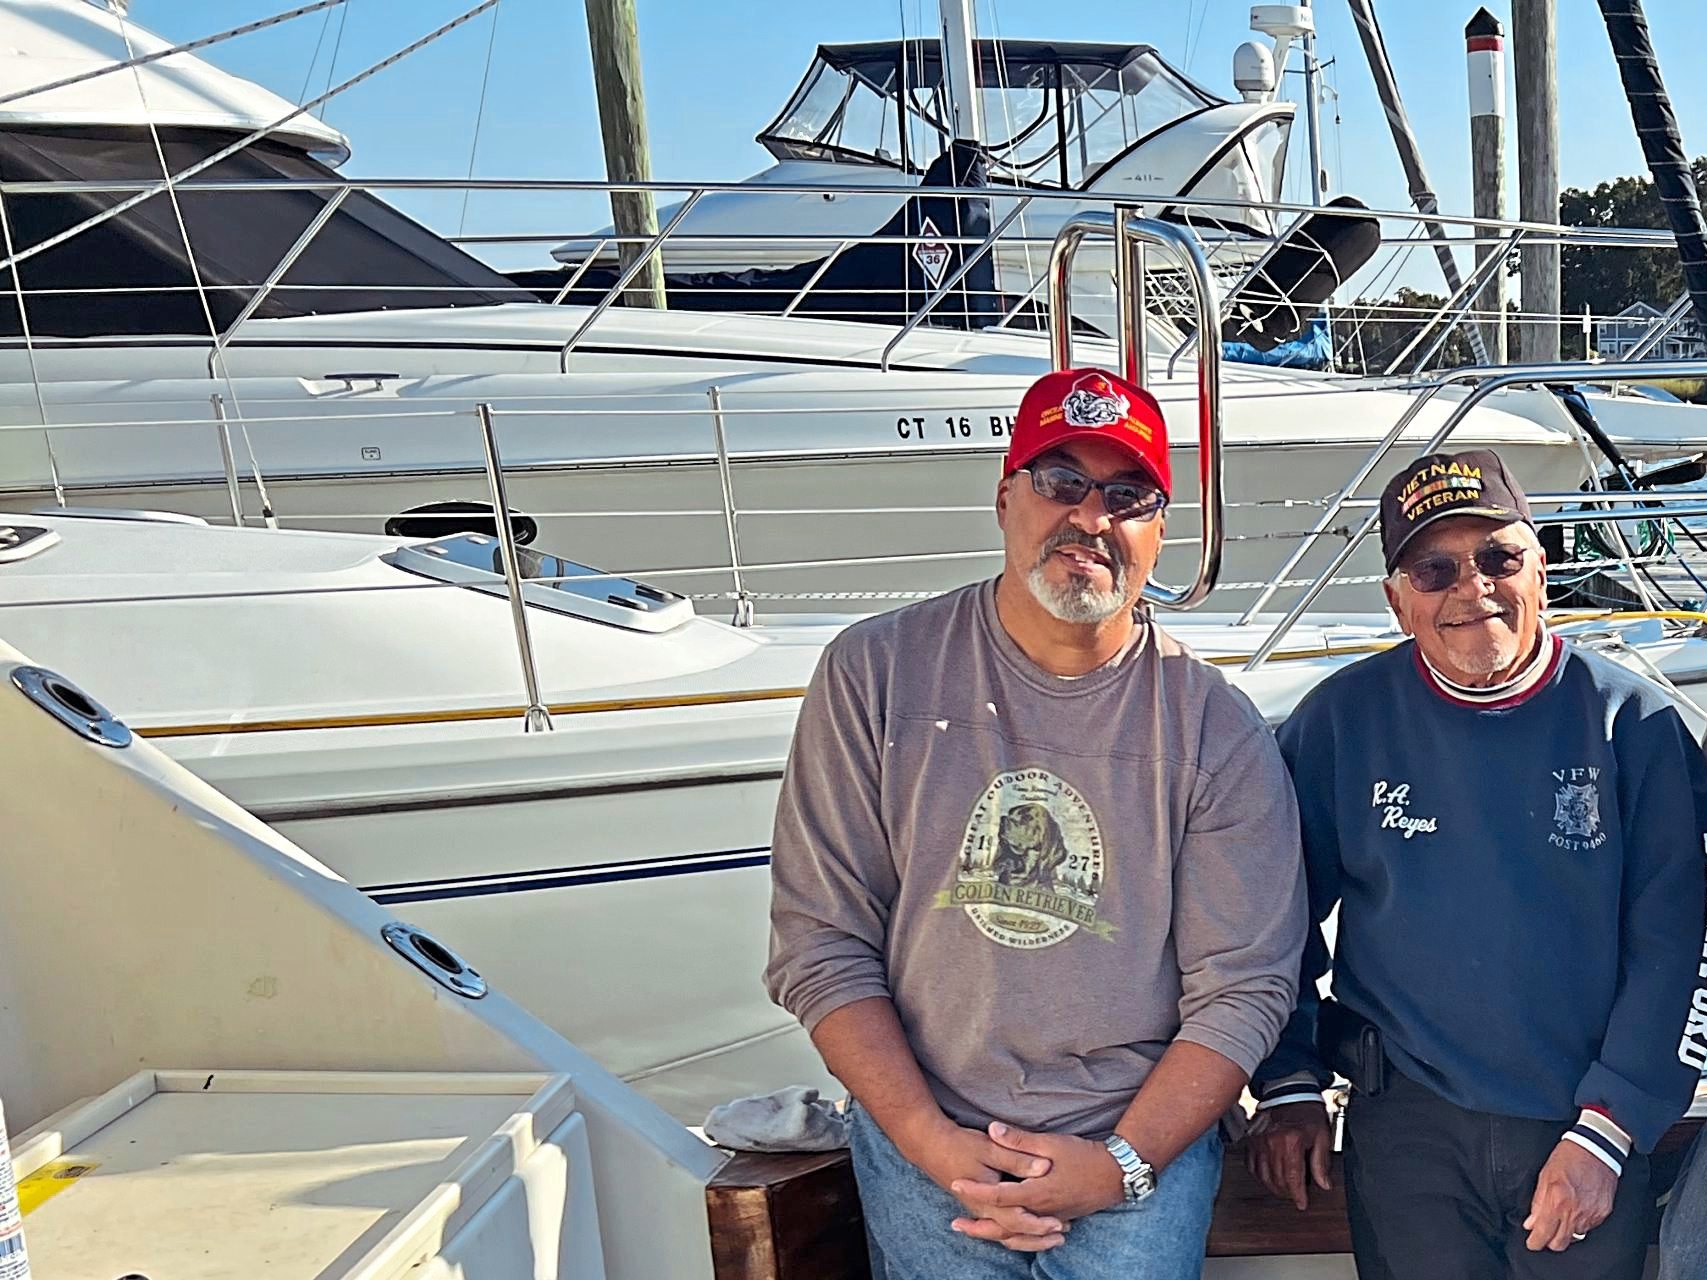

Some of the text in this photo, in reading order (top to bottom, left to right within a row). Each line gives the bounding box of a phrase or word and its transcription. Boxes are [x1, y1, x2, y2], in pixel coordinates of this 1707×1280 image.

[926, 255, 941, 265] 36
[897, 417, 925, 439] CT
[945, 416, 971, 438] 16
[1397, 462, 1482, 503] VIETNAM
[1406, 489, 1480, 521] VETERAN
[1552, 766, 1600, 783] VFW
[1372, 780, 1411, 808] R.A.
[1380, 805, 1438, 840] Reyes
[1548, 832, 1580, 851] POST
[1068, 854, 1090, 872] 27
[954, 883, 1096, 924] GOLDEN RETRIEVER
